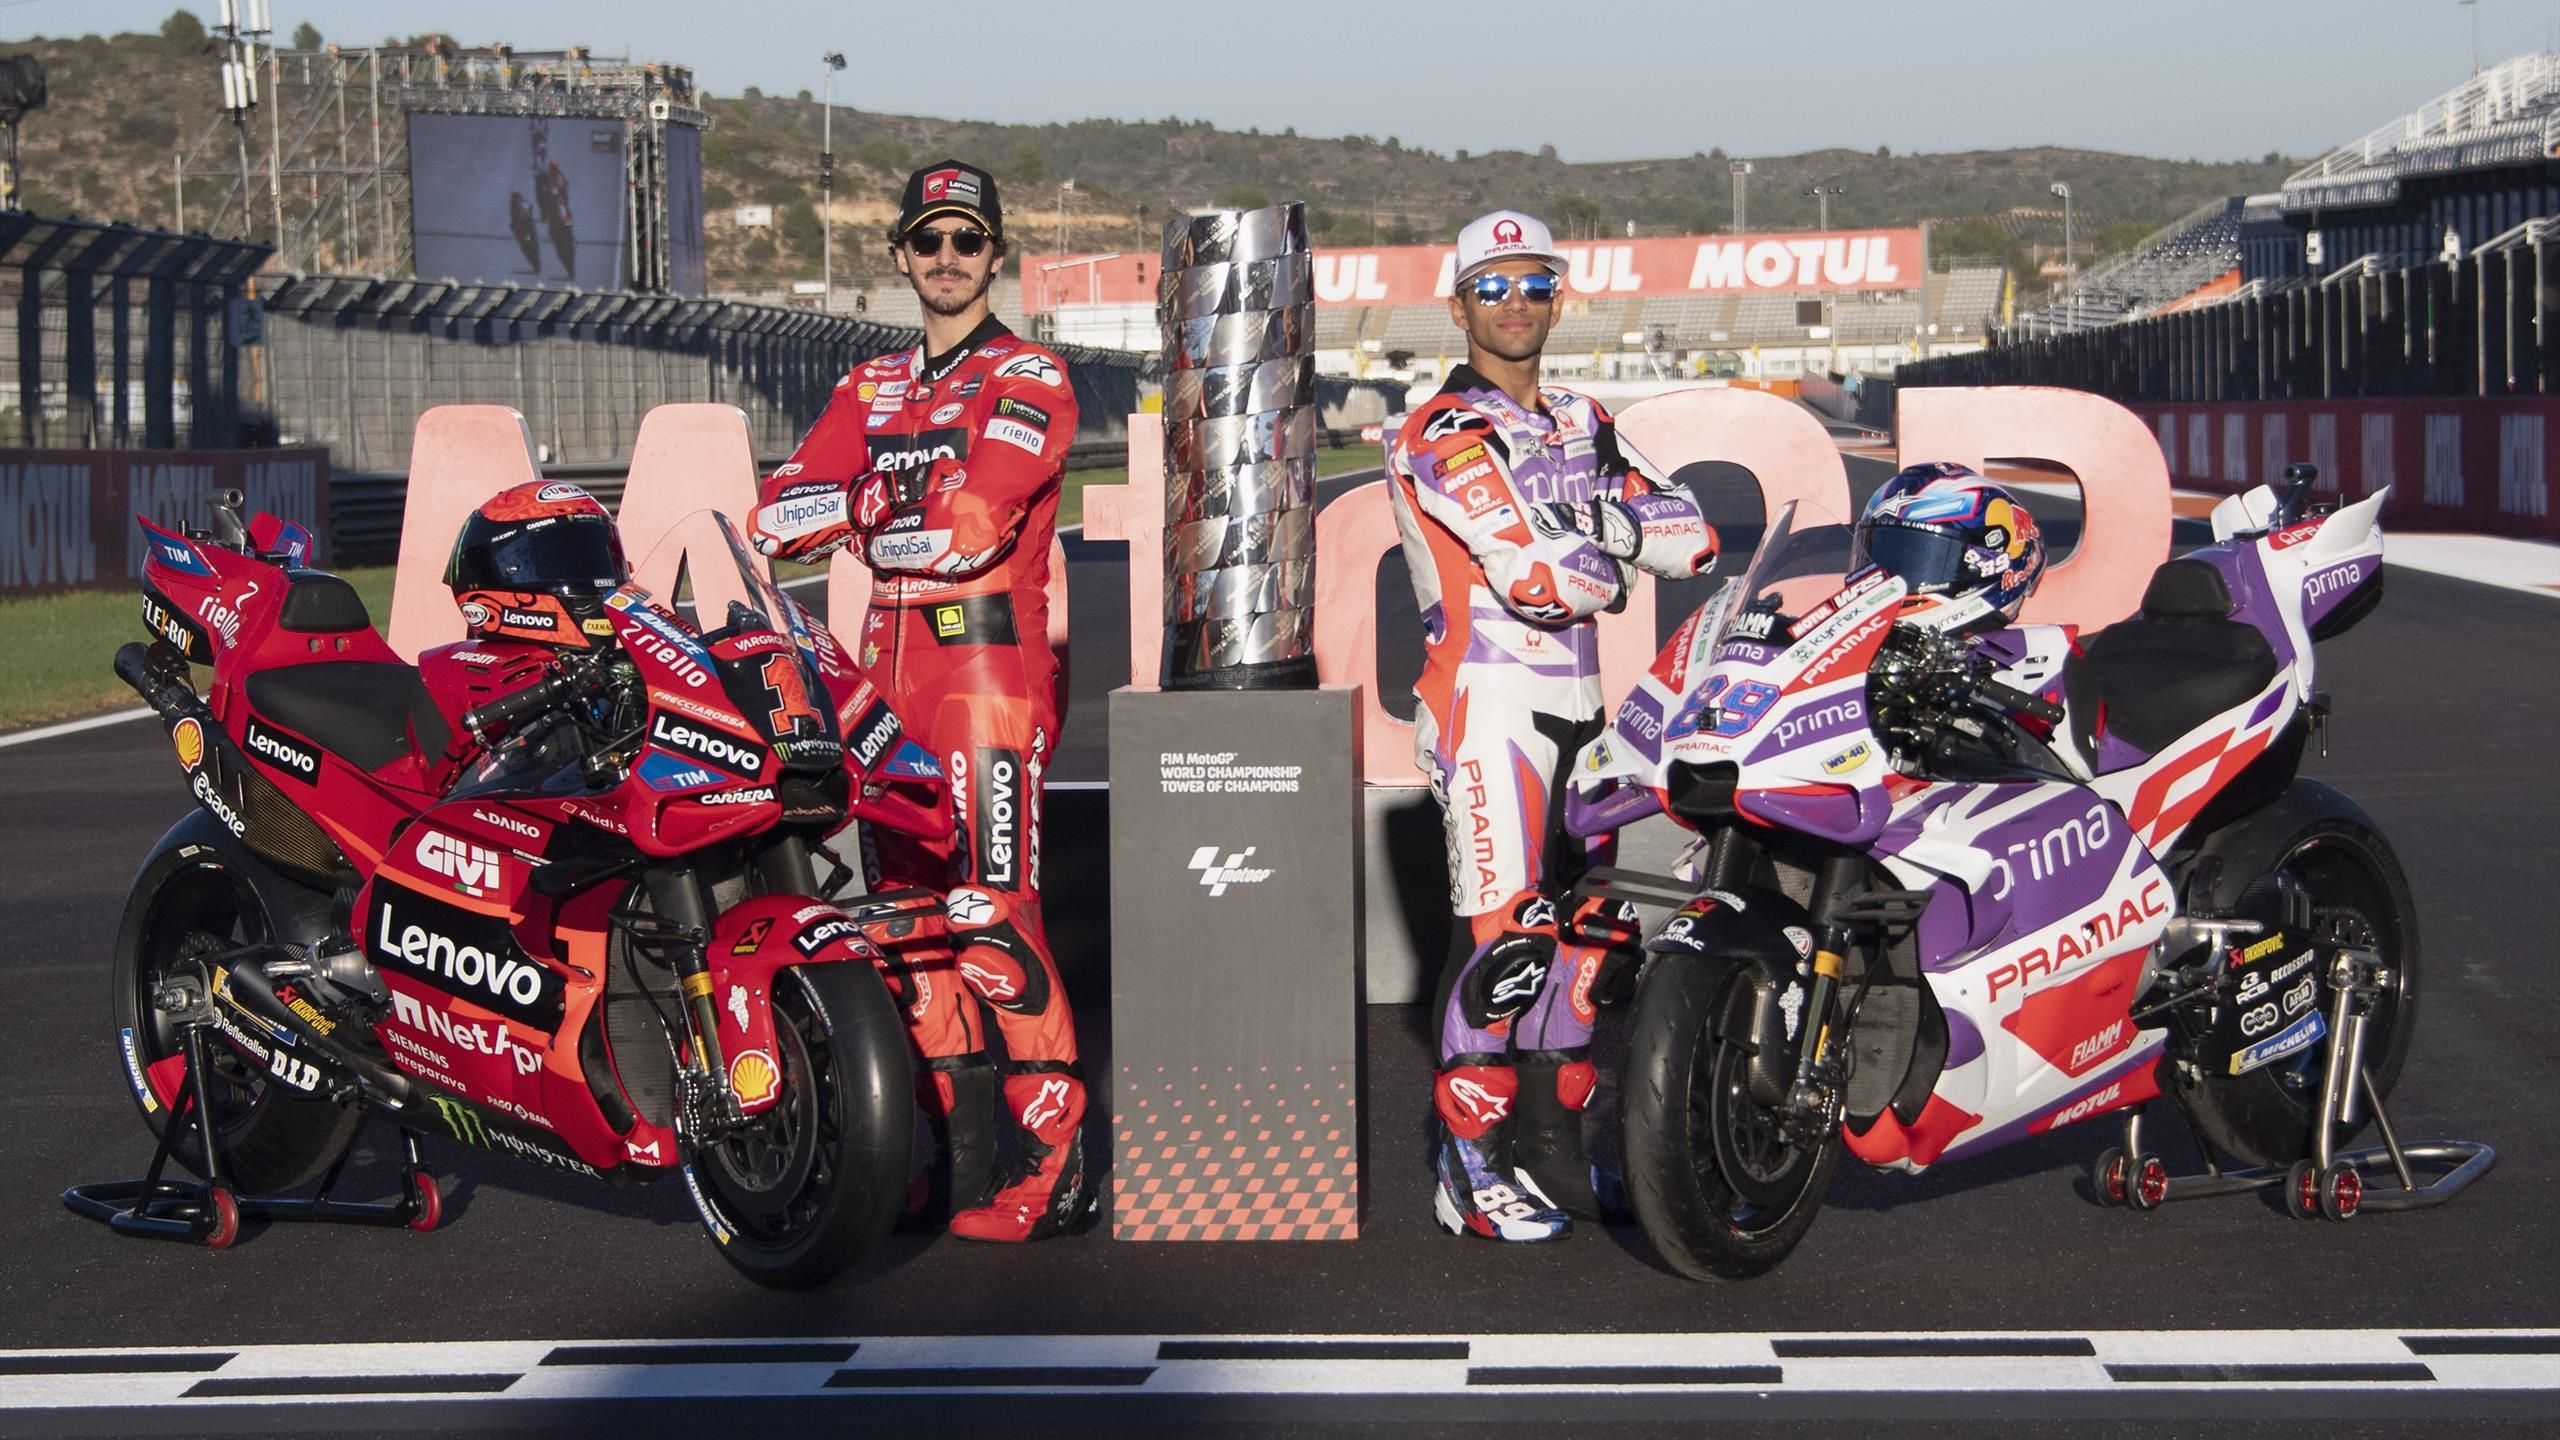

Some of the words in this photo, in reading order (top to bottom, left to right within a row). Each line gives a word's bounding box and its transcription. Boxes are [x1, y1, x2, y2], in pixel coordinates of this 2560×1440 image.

[948, 180, 977, 193] Lenovo
[1483, 243, 1535, 256] PRAMAC
[1688, 236, 1899, 290] MOTUL
[932, 348, 970, 381] Lenovo
[1002, 423, 1040, 448] riello
[1444, 461, 1493, 495] MOTUL
[775, 496, 842, 527] UnipolSai
[1640, 501, 1686, 521] prima
[1642, 522, 1701, 539] PRAMAC
[163, 545, 192, 565] TIM
[287, 541, 304, 558] TIM
[875, 535, 933, 561] UnipolSai
[1568, 574, 1613, 603] PRAMAC
[2303, 561, 2361, 606] prima
[142, 594, 194, 658] FLEX-BOX
[198, 596, 240, 642] riello
[503, 609, 554, 627] Lenovo
[449, 650, 499, 666] DUCATI
[635, 630, 709, 689] riello
[1801, 614, 1889, 685] PRAMAC
[651, 690, 747, 729] FRECCIAROSSA
[761, 653, 826, 737] 1
[1662, 673, 1784, 743] 89
[850, 711, 899, 768] Lenovo
[1620, 699, 1662, 742] prima
[1772, 699, 1863, 748] prima
[247, 724, 315, 773] Lenovo
[653, 715, 761, 771] Lenovo
[1160, 753, 1184, 765] FIM
[1672, 740, 1732, 755] PRAMAC
[1825, 744, 1866, 771] WD-40
[672, 769, 710, 788] TIM
[1160, 766, 1205, 779] WORLD
[1207, 766, 1302, 779] CHAMPIONSHIP
[1160, 780, 1205, 793] TOWER
[1206, 780, 1223, 792] OF
[1224, 780, 1300, 793] CHAMPIONS
[700, 788, 776, 805] CARRERA
[487, 811, 541, 839] DAIKO
[579, 809, 614, 830] Audi
[986, 760, 1013, 883] Lenovo
[1460, 758, 1501, 907] PRAMAC
[415, 829, 500, 889] GIVI
[1992, 803, 2112, 902] prima
[379, 902, 543, 1005] Lenovo
[1985, 878, 2167, 1004] PRAMAC
[221, 1017, 270, 1062] Reflexallen
[386, 1028, 450, 1070] SIEMENS
[2071, 1018, 2123, 1066] FIAMM
[2260, 1020, 2318, 1059] MICHELIN
[270, 1048, 321, 1092] D.I.D
[394, 1050, 467, 1093] streparava
[2048, 1082, 2122, 1131] MOTUL
[487, 1127, 604, 1180] MONSTER
[630, 1156, 662, 1167] MARELLI
